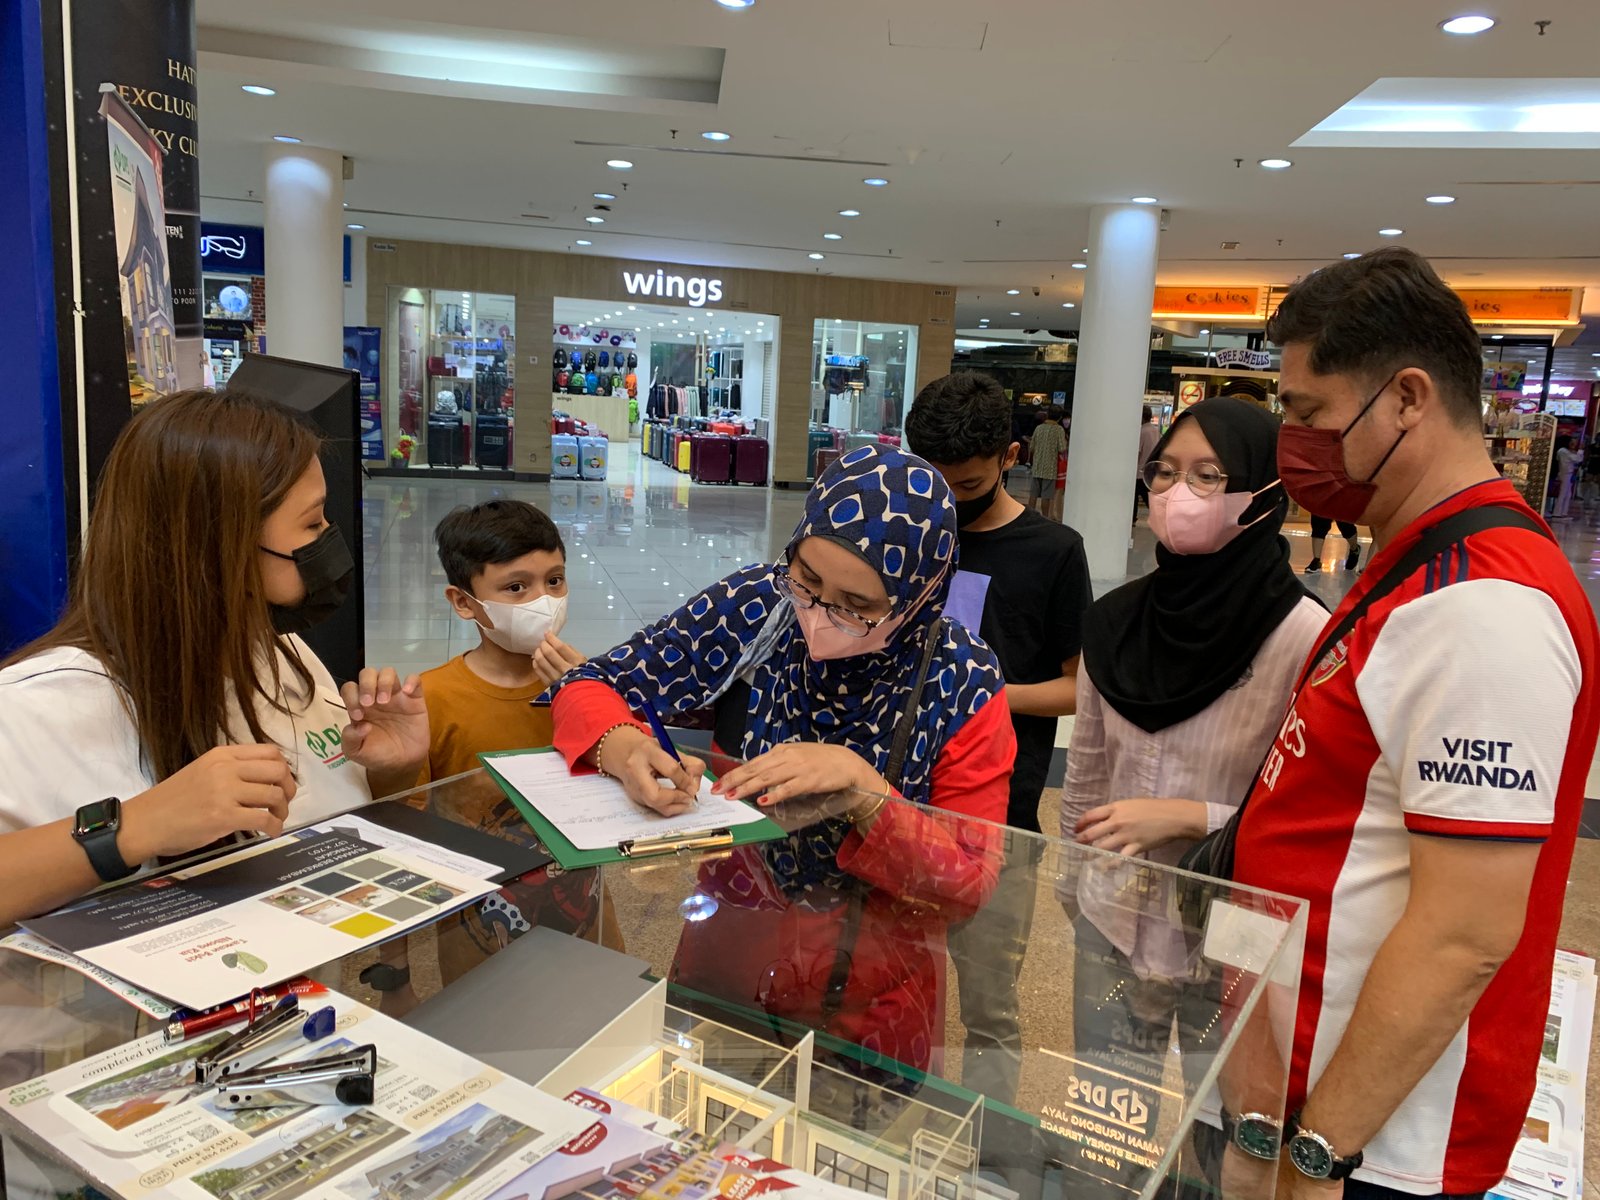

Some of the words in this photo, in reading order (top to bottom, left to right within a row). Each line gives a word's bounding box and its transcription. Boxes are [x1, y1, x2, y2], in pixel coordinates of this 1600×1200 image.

[623, 269, 723, 307] wings
[1217, 350, 1238, 364] FREE
[1238, 350, 1270, 365] SMELLS
[1442, 737, 1513, 764] VISIT
[1418, 760, 1538, 792] RWANDA
[82, 1050, 145, 1079] completed
[726, 1172, 749, 1198] LEASE
[735, 1178, 756, 1200] HOLD
